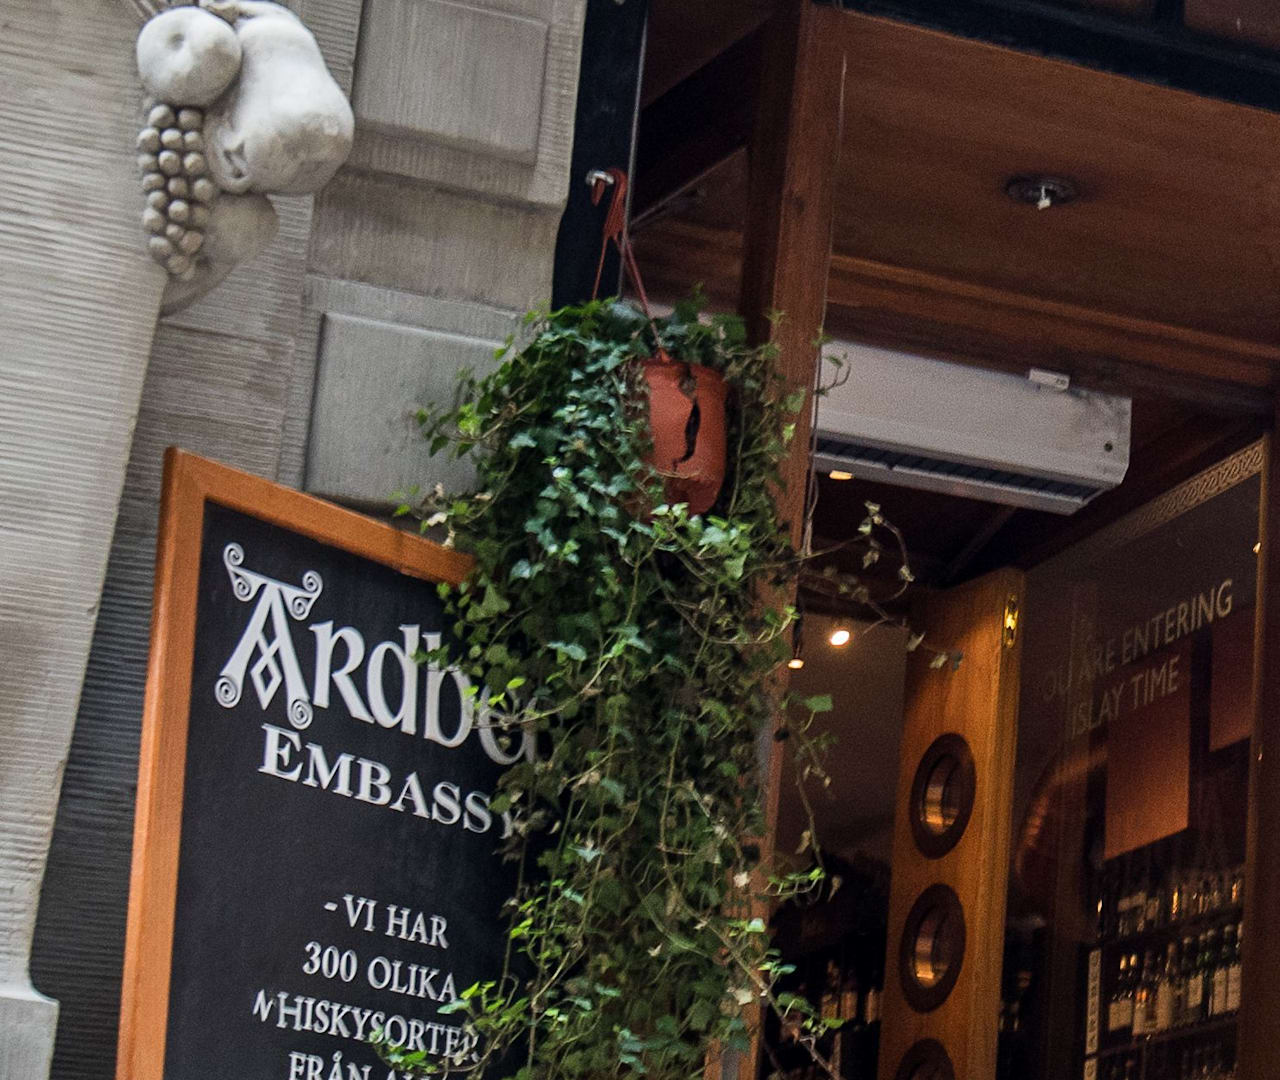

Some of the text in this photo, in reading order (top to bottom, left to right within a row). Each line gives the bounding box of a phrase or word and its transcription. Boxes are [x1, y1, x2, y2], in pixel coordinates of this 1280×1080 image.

[1122, 577, 1233, 666] ENTERING
[1131, 655, 1181, 711] TIME
[385, 905, 450, 949] HAR
[302, 940, 458, 1004] 300 OLIKA
